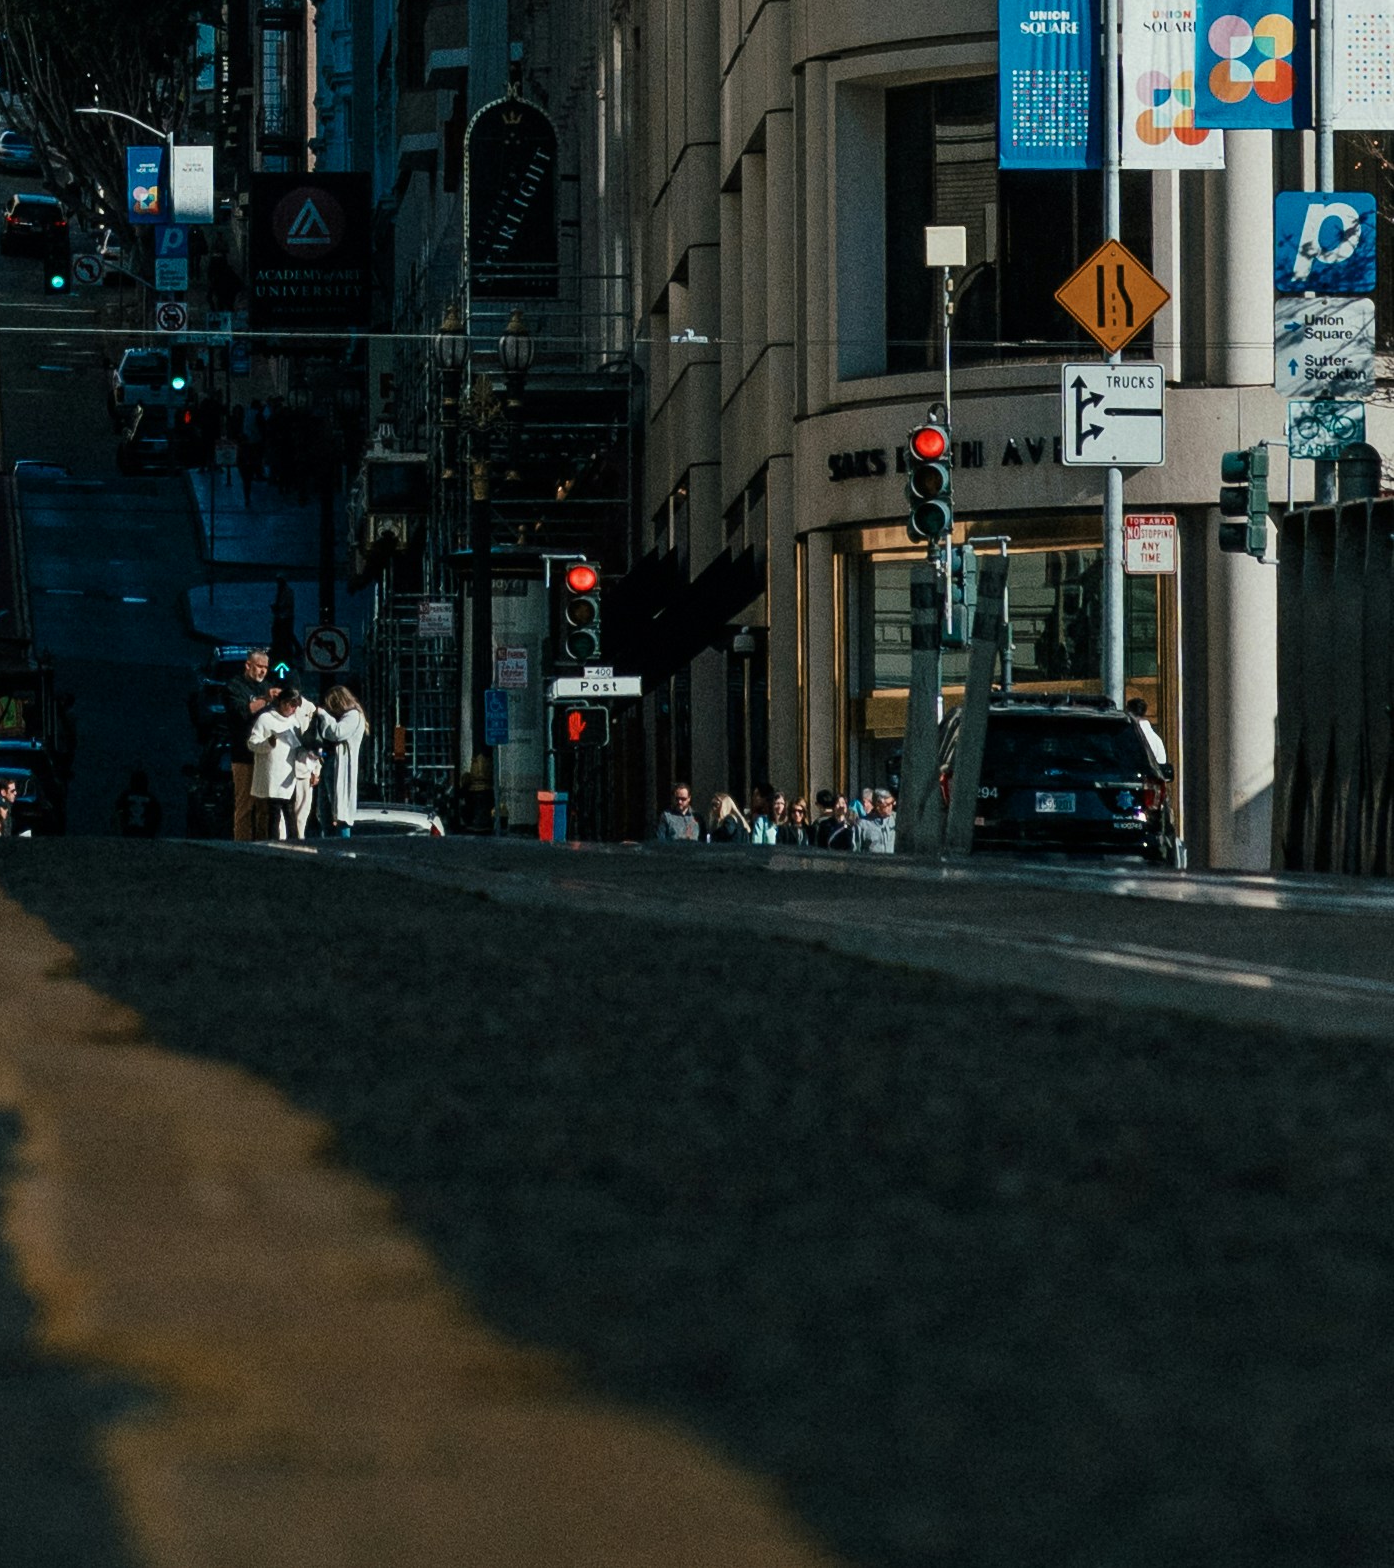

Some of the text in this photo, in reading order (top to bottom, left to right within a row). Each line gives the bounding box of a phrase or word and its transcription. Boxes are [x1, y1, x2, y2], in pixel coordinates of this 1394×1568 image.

[1030, 11, 1071, 21] UNION
[1152, 10, 1192, 19] UNION
[1020, 21, 1080, 37] SQUARE
[255, 269, 323, 281] ACADEMY
[335, 269, 361, 280] ART
[255, 285, 363, 297] UNIVERSITY
[1304, 313, 1345, 327] Union
[1304, 327, 1353, 342] Square
[1304, 354, 1353, 367] Sutter-
[1304, 368, 1367, 381] Stockton
[1106, 375, 1155, 389] TRUCKS
[828, 449, 887, 482] SAKS
[1128, 517, 1174, 526] TOW-AWAY
[1127, 526, 1173, 539] NO STOPPING
[1141, 541, 1161, 552] ANY
[1140, 553, 1162, 563] TIME
[580, 681, 618, 692] Post
